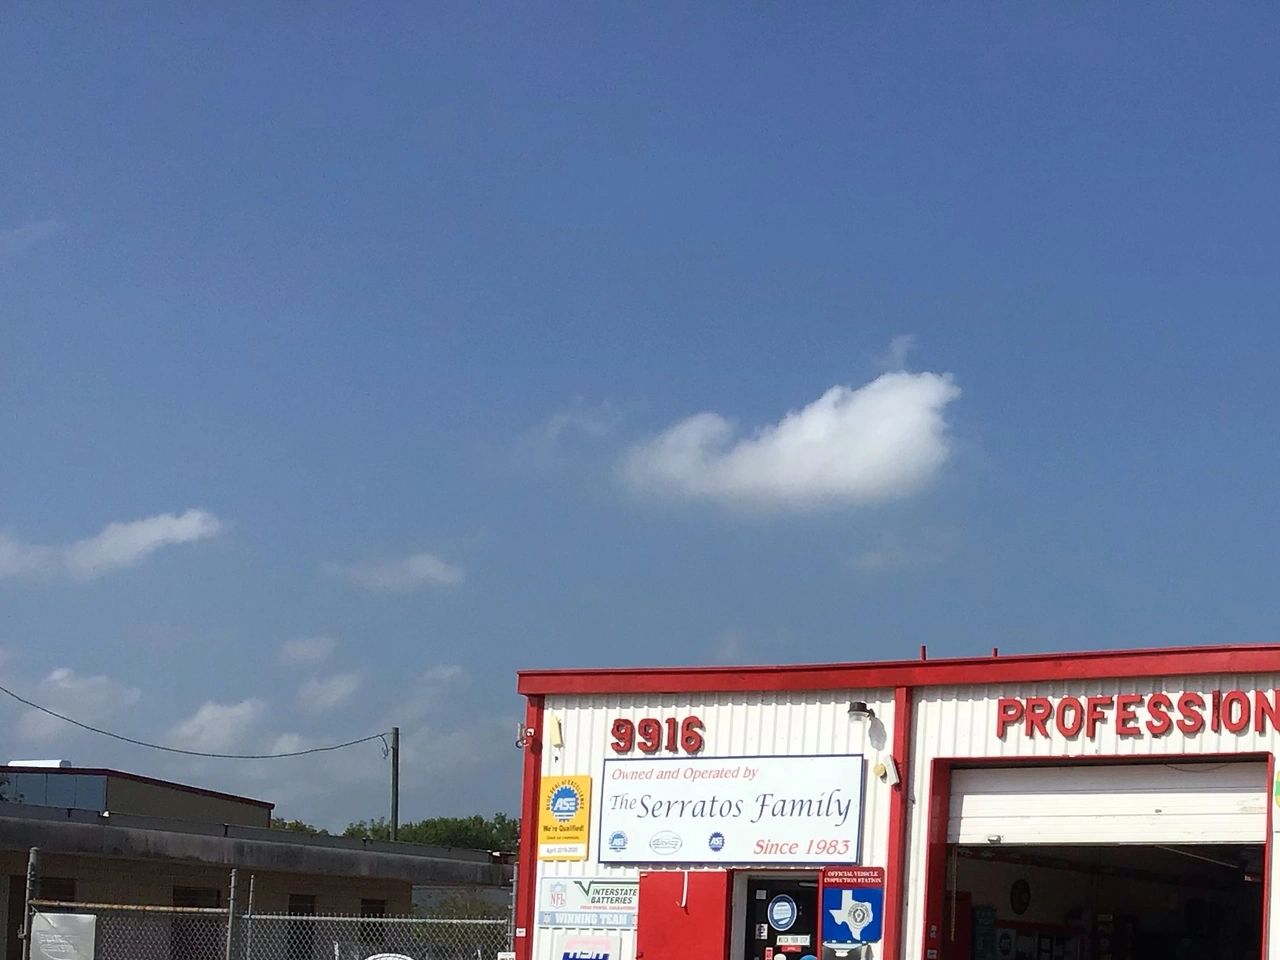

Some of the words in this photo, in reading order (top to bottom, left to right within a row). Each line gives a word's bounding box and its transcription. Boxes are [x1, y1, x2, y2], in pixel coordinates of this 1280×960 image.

[610, 715, 706, 754] 9916
[611, 768, 654, 781] Owned
[656, 767, 681, 780] and
[683, 766, 741, 782] Operated
[743, 766, 759, 781] by
[553, 797, 577, 811] ASE
[610, 792, 637, 811] The
[637, 794, 744, 819] Serratos
[750, 789, 853, 827] Family
[753, 840, 798, 855] Since
[804, 839, 850, 855] 1983
[550, 894, 565, 905] NFL
[592, 888, 638, 897] INTERSTATE
[591, 896, 633, 905] BATTERIES
[554, 913, 599, 924] WINNING
[600, 913, 628, 925] TEAM
